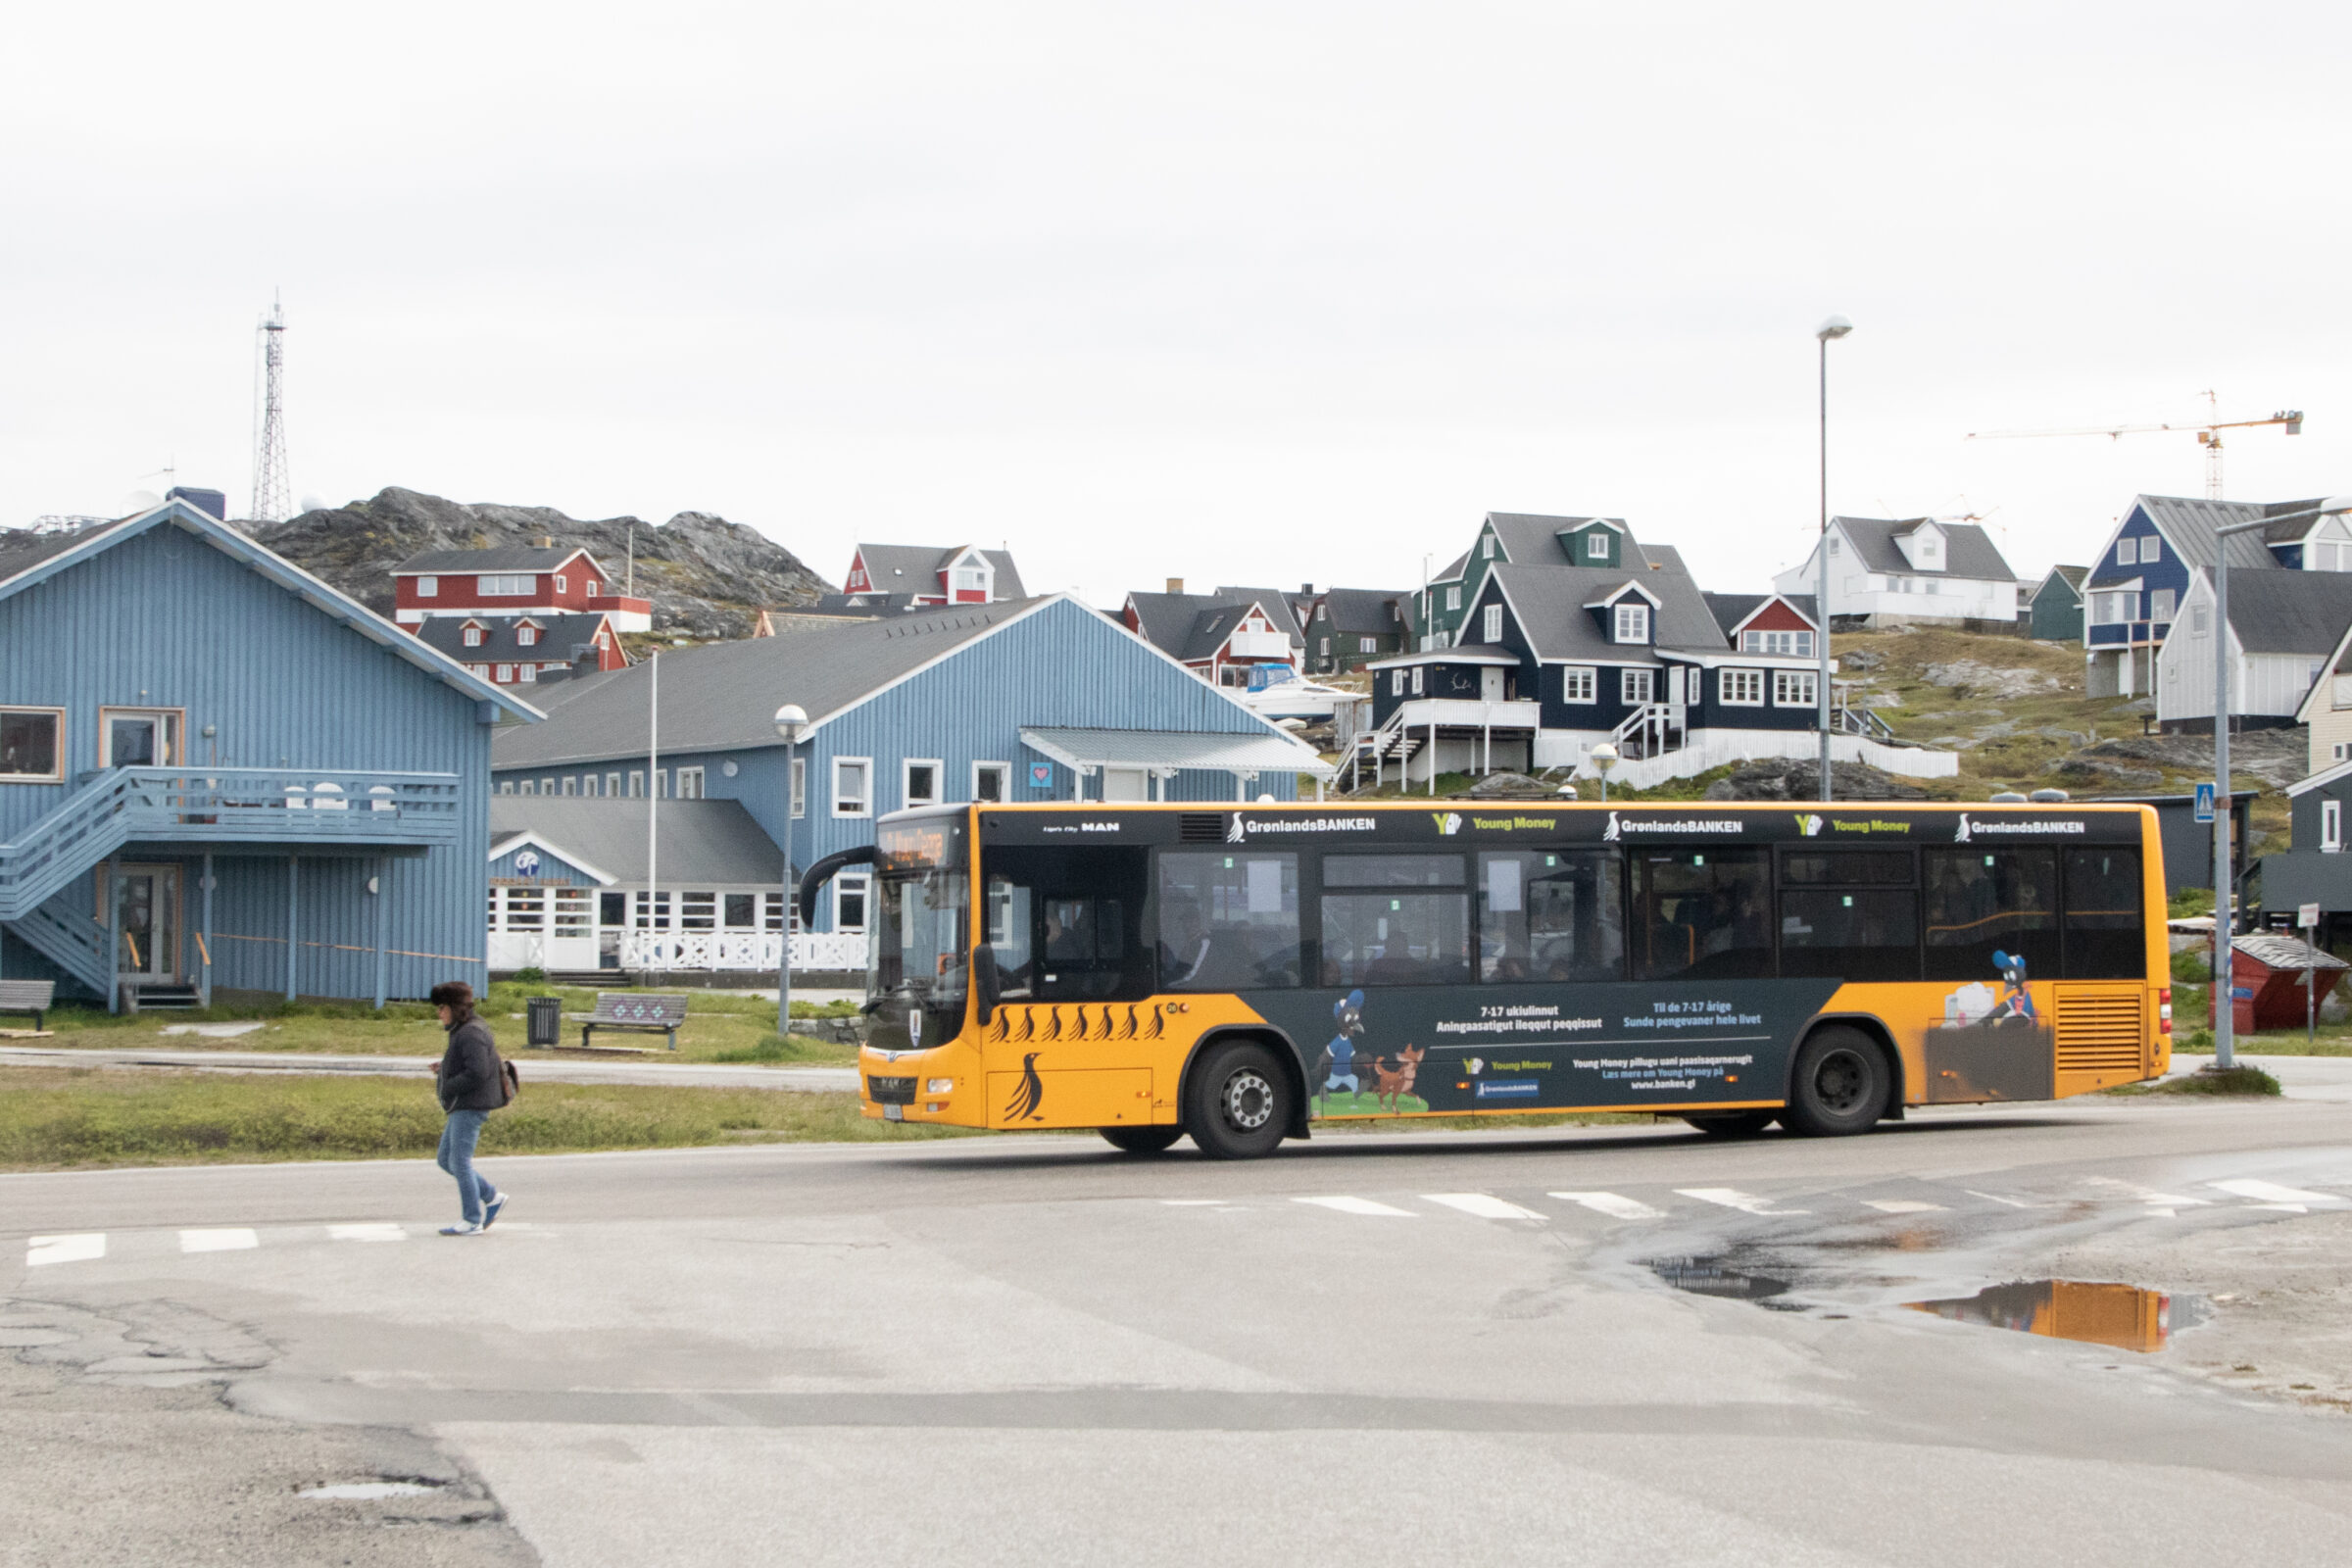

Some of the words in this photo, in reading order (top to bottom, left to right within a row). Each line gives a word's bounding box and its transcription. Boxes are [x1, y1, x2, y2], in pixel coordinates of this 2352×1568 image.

[1081, 822, 1120, 832] MAN
[1246, 818, 1376, 833] GrønlandsBANKEN
[1472, 817, 1513, 831] Young
[1514, 817, 1556, 831] Money
[1621, 819, 1743, 833] GrønlandsBANKEN
[1833, 820, 1870, 833] Young
[1871, 820, 1911, 833] Money
[1971, 821, 2085, 833] GrønlandsBANKEN
[1481, 1006, 1504, 1017] 7-17
[1506, 1005, 1559, 1017] ukiulinnut
[1653, 1003, 1666, 1013] Til
[1667, 1002, 1680, 1012] de
[1682, 1001, 1704, 1012] 7-17
[1706, 1000, 1732, 1013] årige
[1436, 1019, 1514, 1034] Aningaasatigut
[1515, 1018, 1551, 1032] ileqqut
[1553, 1017, 1603, 1031] peqqissut
[1623, 1016, 1655, 1028] Sunde
[1656, 1016, 1714, 1029] pengevaner
[1716, 1014, 1738, 1025] hele
[1739, 1013, 1762, 1025] livet
[1491, 1061, 1520, 1071] Young
[1521, 1060, 1552, 1071] Money
[1573, 1059, 1599, 1070] Young
[1600, 1058, 1628, 1069] Money
[1630, 1057, 1659, 1068] pillugu
[1658, 1068, 1683, 1078] Young
[1684, 1067, 1713, 1078] Money
[1714, 1066, 1724, 1077] på
